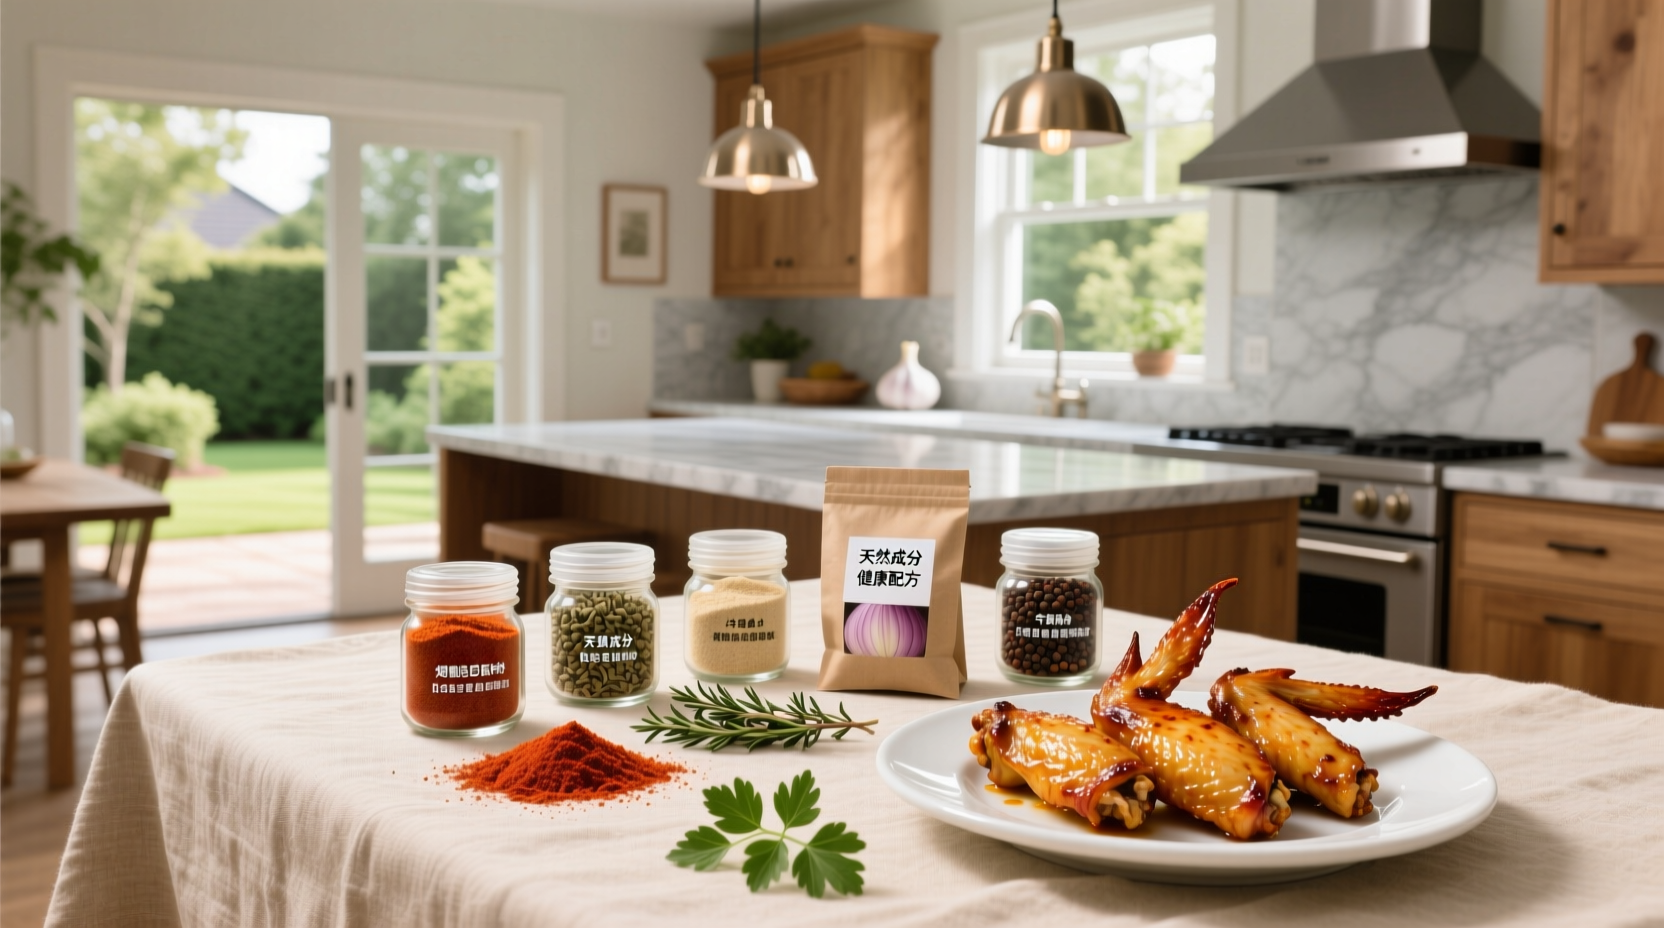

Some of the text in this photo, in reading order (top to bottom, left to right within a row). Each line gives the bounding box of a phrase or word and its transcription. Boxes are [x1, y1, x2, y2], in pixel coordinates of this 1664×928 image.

[859, 548, 923, 566] 天然成分
[857, 569, 922, 588] 健康配方
